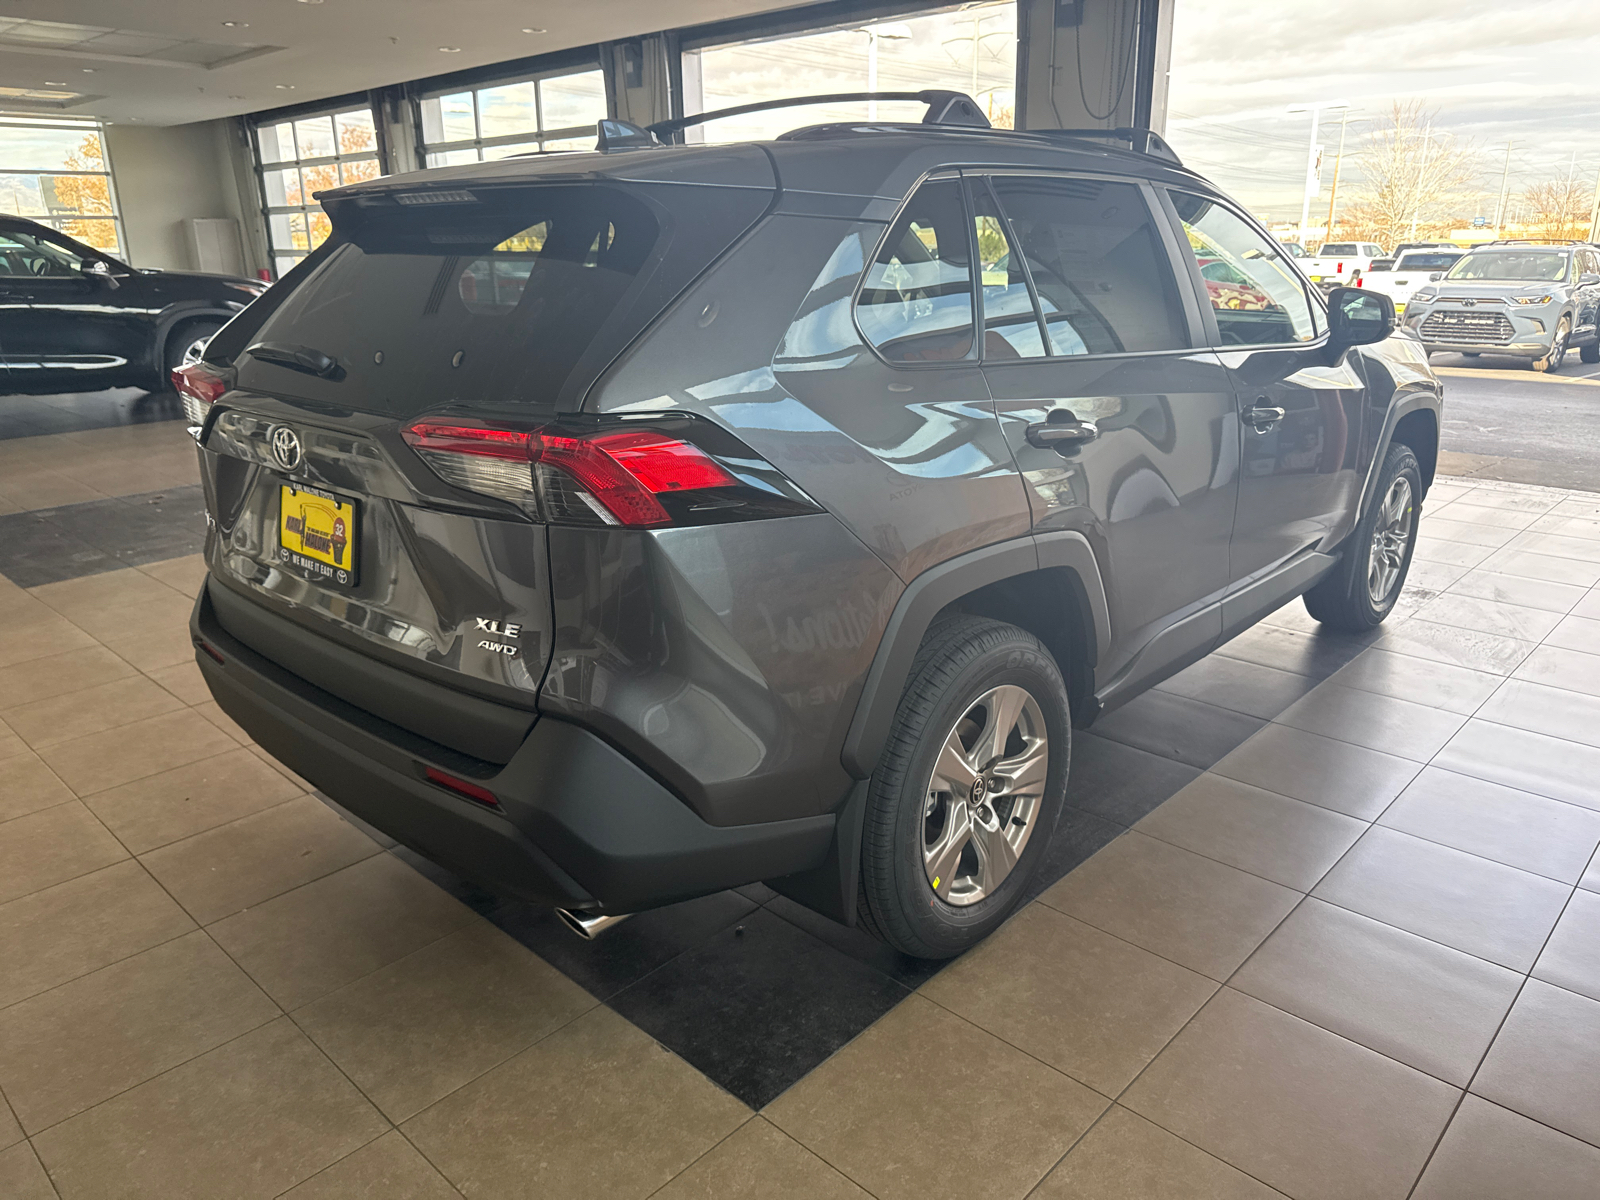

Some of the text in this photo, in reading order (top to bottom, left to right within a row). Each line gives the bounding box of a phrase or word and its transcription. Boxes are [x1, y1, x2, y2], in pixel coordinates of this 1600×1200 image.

[335, 523, 343, 537] 32
[292, 554, 333, 577] WE MAKE IT EASY
[473, 616, 522, 638] XLE
[477, 640, 517, 656] AWD
